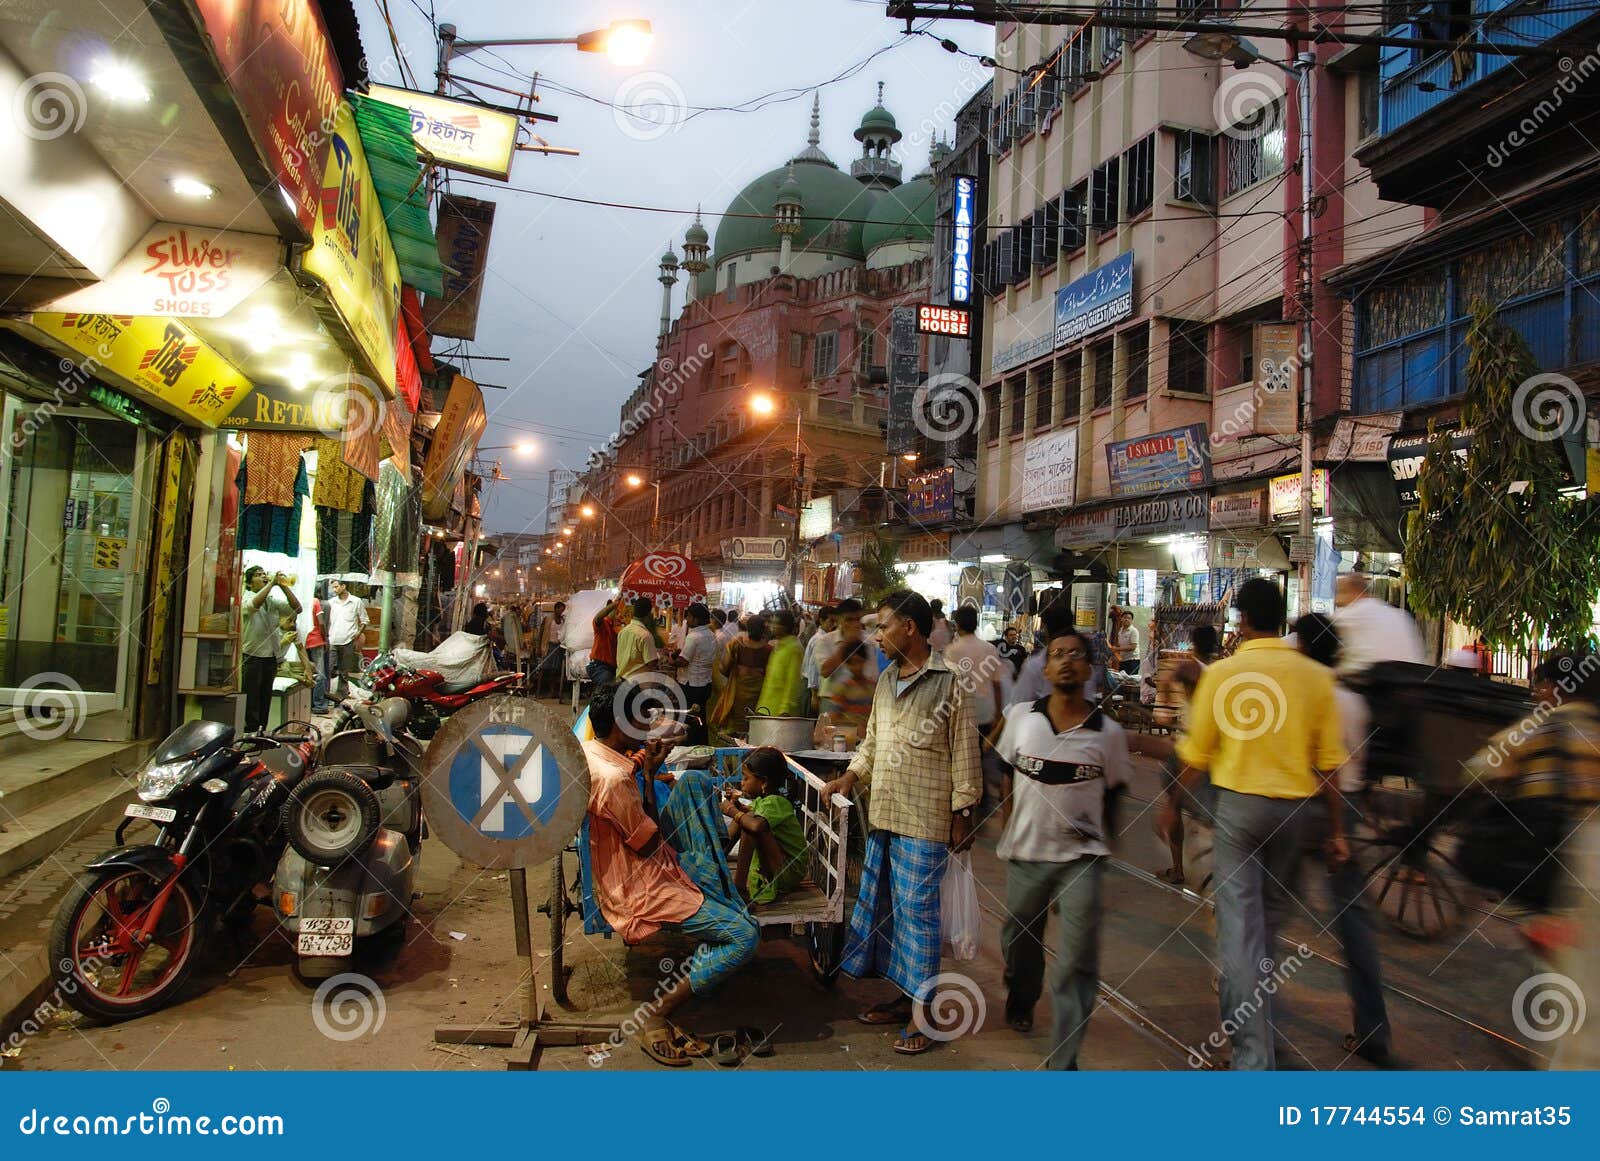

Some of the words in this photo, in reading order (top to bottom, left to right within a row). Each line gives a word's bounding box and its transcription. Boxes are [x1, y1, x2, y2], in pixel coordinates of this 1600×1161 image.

[954, 177, 971, 301] STANDARD
[154, 298, 211, 315] SHOES
[920, 307, 968, 322] GUEST
[919, 319, 968, 335] HOUSE
[1055, 314, 1088, 343] STANDARD
[1088, 304, 1108, 328] GUEST
[1108, 293, 1131, 320] HOUSE
[1127, 436, 1174, 459] ISMAIL
[1115, 499, 1169, 528] HAMEED
[1172, 497, 1182, 519] &
[638, 578, 667, 586] KWALITY
